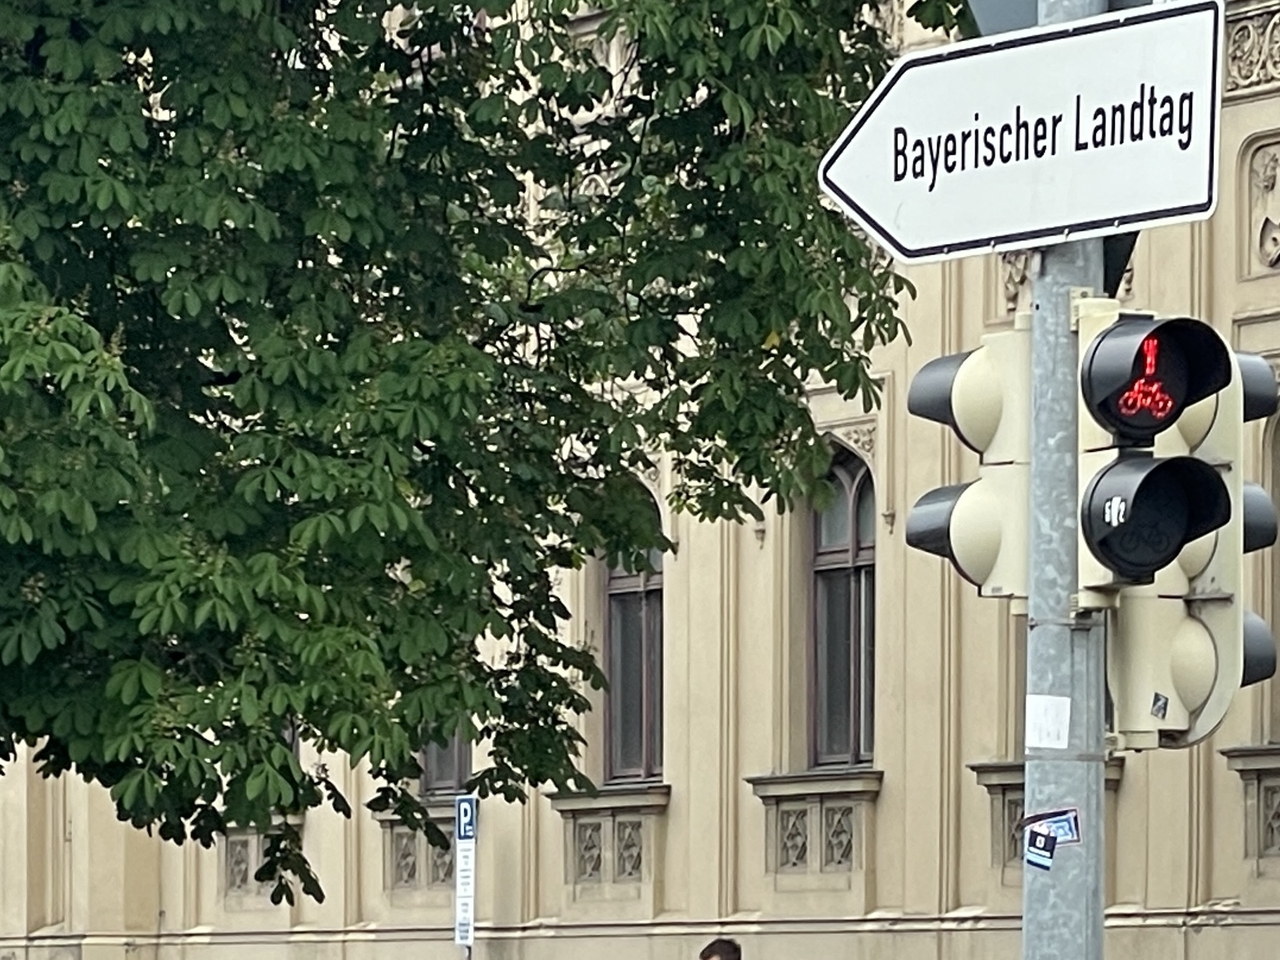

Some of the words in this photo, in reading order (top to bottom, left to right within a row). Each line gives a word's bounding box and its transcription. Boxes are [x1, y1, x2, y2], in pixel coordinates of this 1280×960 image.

[893, 105, 1063, 192] Bayerischer
[1074, 83, 1195, 152] Landtag
[460, 801, 471, 837] P
